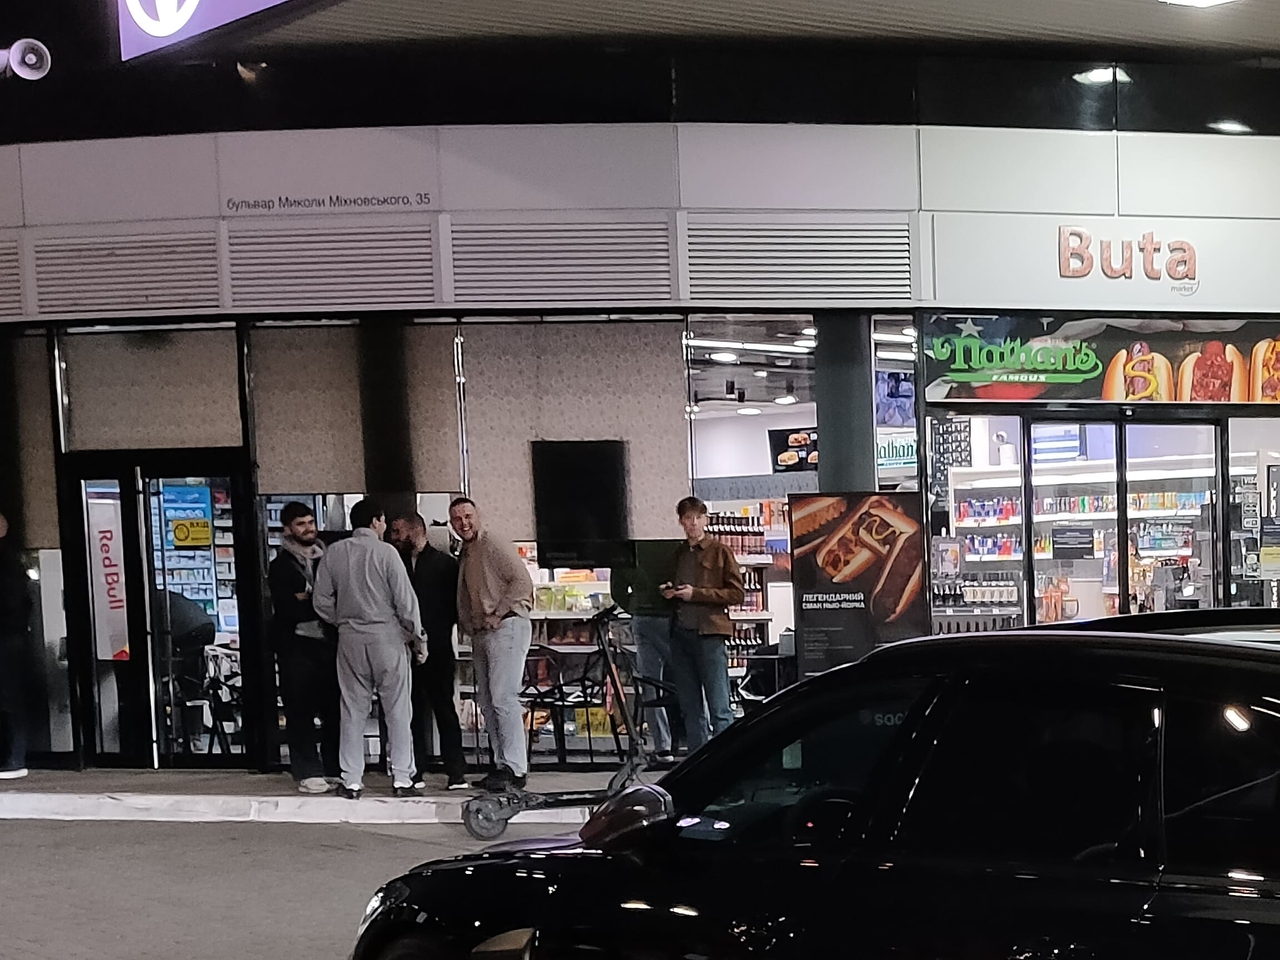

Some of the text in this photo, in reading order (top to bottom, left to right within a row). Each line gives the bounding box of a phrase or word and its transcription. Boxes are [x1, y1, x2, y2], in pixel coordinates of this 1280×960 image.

[227, 193, 431, 212] бульвар Миколи Міхновського, 35
[1058, 225, 1197, 281] Buta
[932, 335, 1098, 373] Nathan's
[991, 374, 1047, 382] FAMOUS
[98, 530, 125, 610] Red Bull
[802, 592, 864, 602] ЛЕГЕНДАРНИЙ
